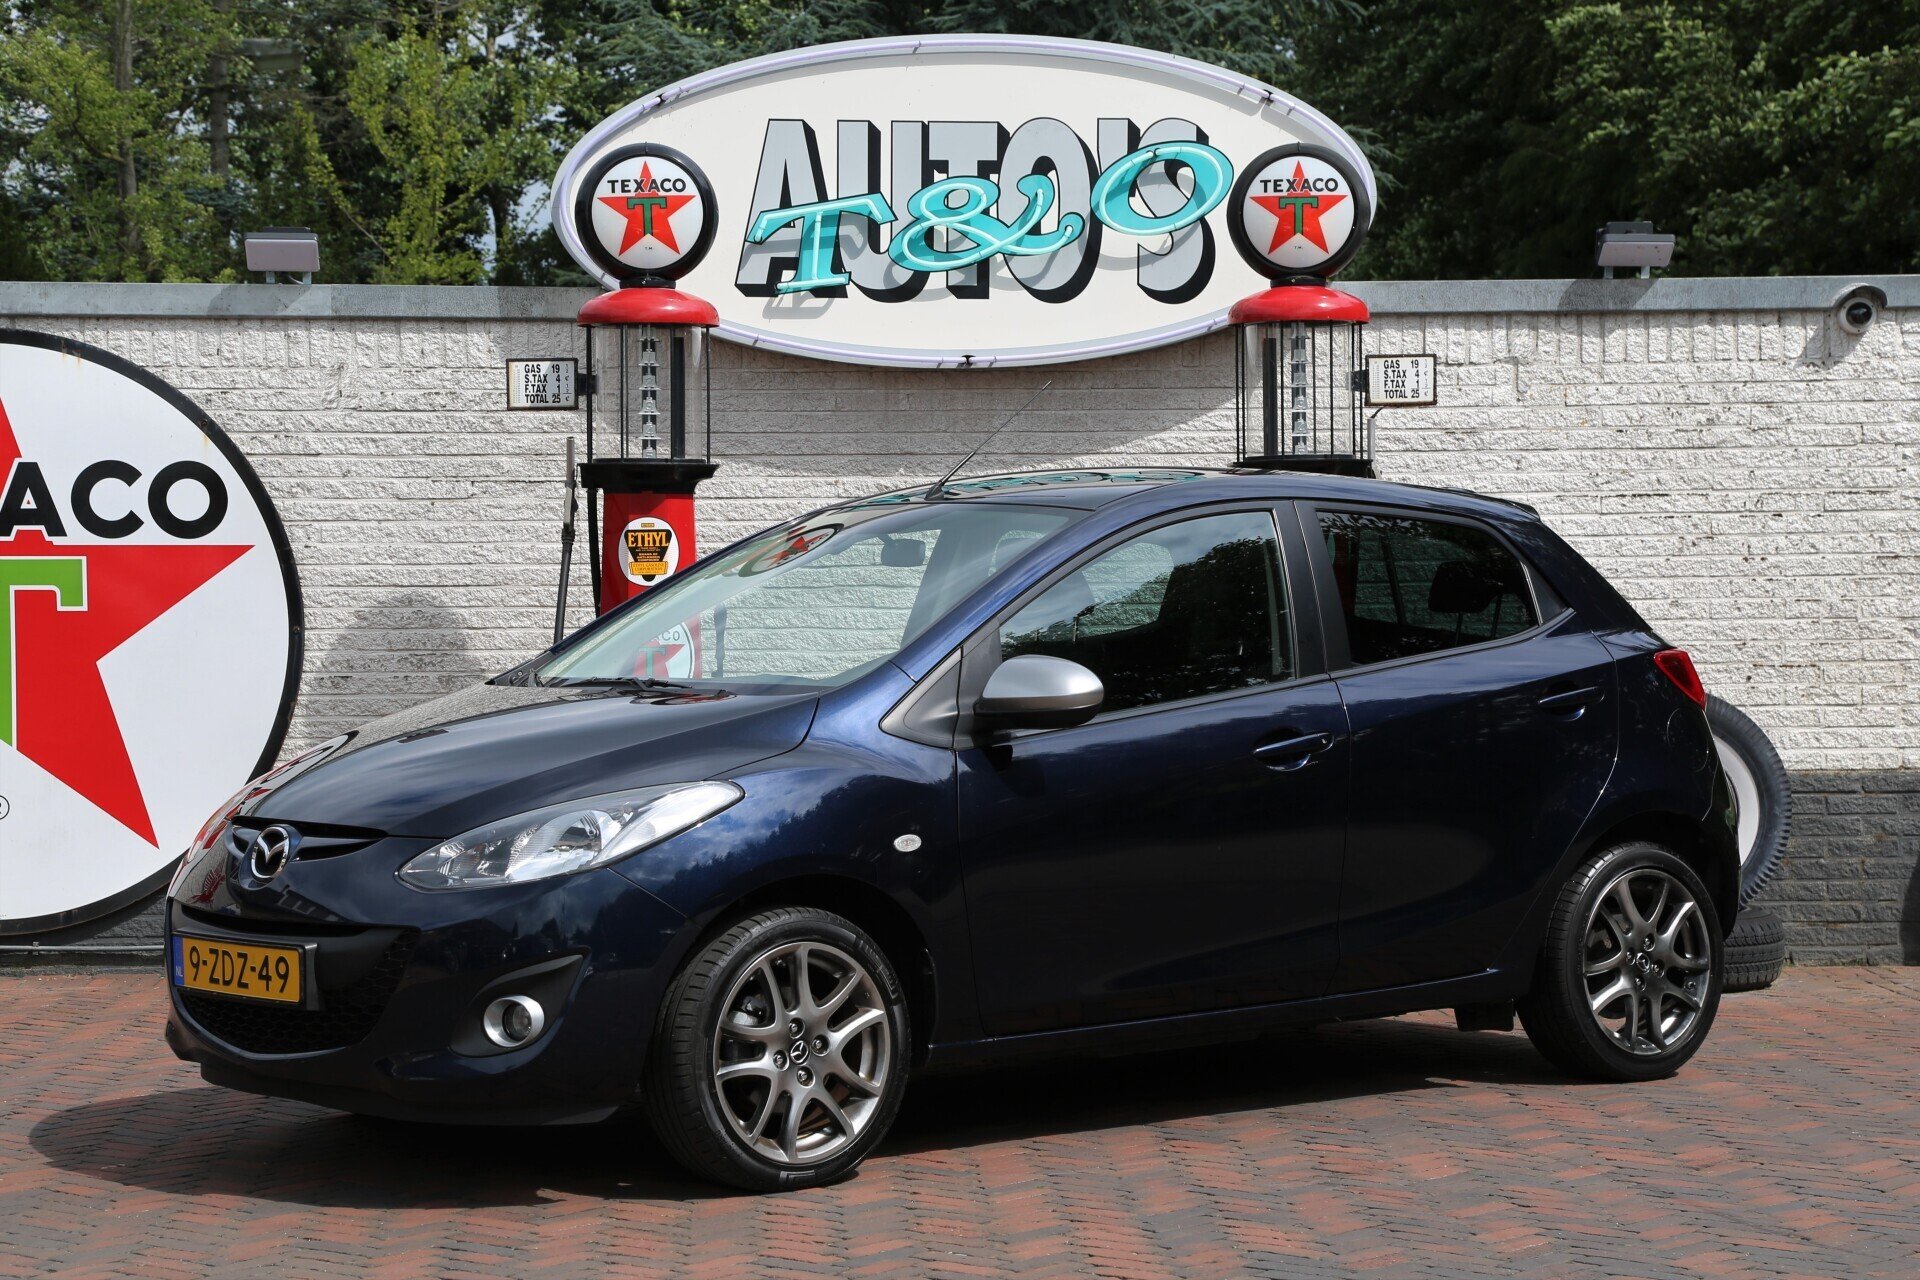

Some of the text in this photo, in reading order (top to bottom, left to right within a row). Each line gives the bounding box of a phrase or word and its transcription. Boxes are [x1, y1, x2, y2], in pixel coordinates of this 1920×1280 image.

[607, 178, 687, 193] TEXACO
[1260, 177, 1339, 193] TEXACO
[735, 116, 1216, 304] AUTO'S
[627, 196, 667, 237] T
[1279, 196, 1319, 236] T
[524, 363, 541, 373] GAS
[551, 363, 560, 373] 19
[1383, 359, 1401, 369] GAS
[1410, 359, 1419, 369] 19
[524, 373, 548, 384] S.TAX
[555, 373, 561, 383] 4
[1383, 369, 1407, 379] S.TAX
[1414, 369, 1420, 378] 4
[524, 383, 547, 394] F.TAX
[556, 384, 561, 393] 1
[1383, 379, 1406, 389] F.TAX
[1415, 379, 1420, 388] 1
[525, 394, 549, 404] TOTAL
[551, 393, 561, 403] 25
[1384, 389, 1408, 399] TOTAL
[1410, 389, 1420, 399] 25
[627, 531, 669, 547] ETHYL
[175, 966, 184, 977] NL
[189, 945, 290, 994] 9-ZDZ-49
